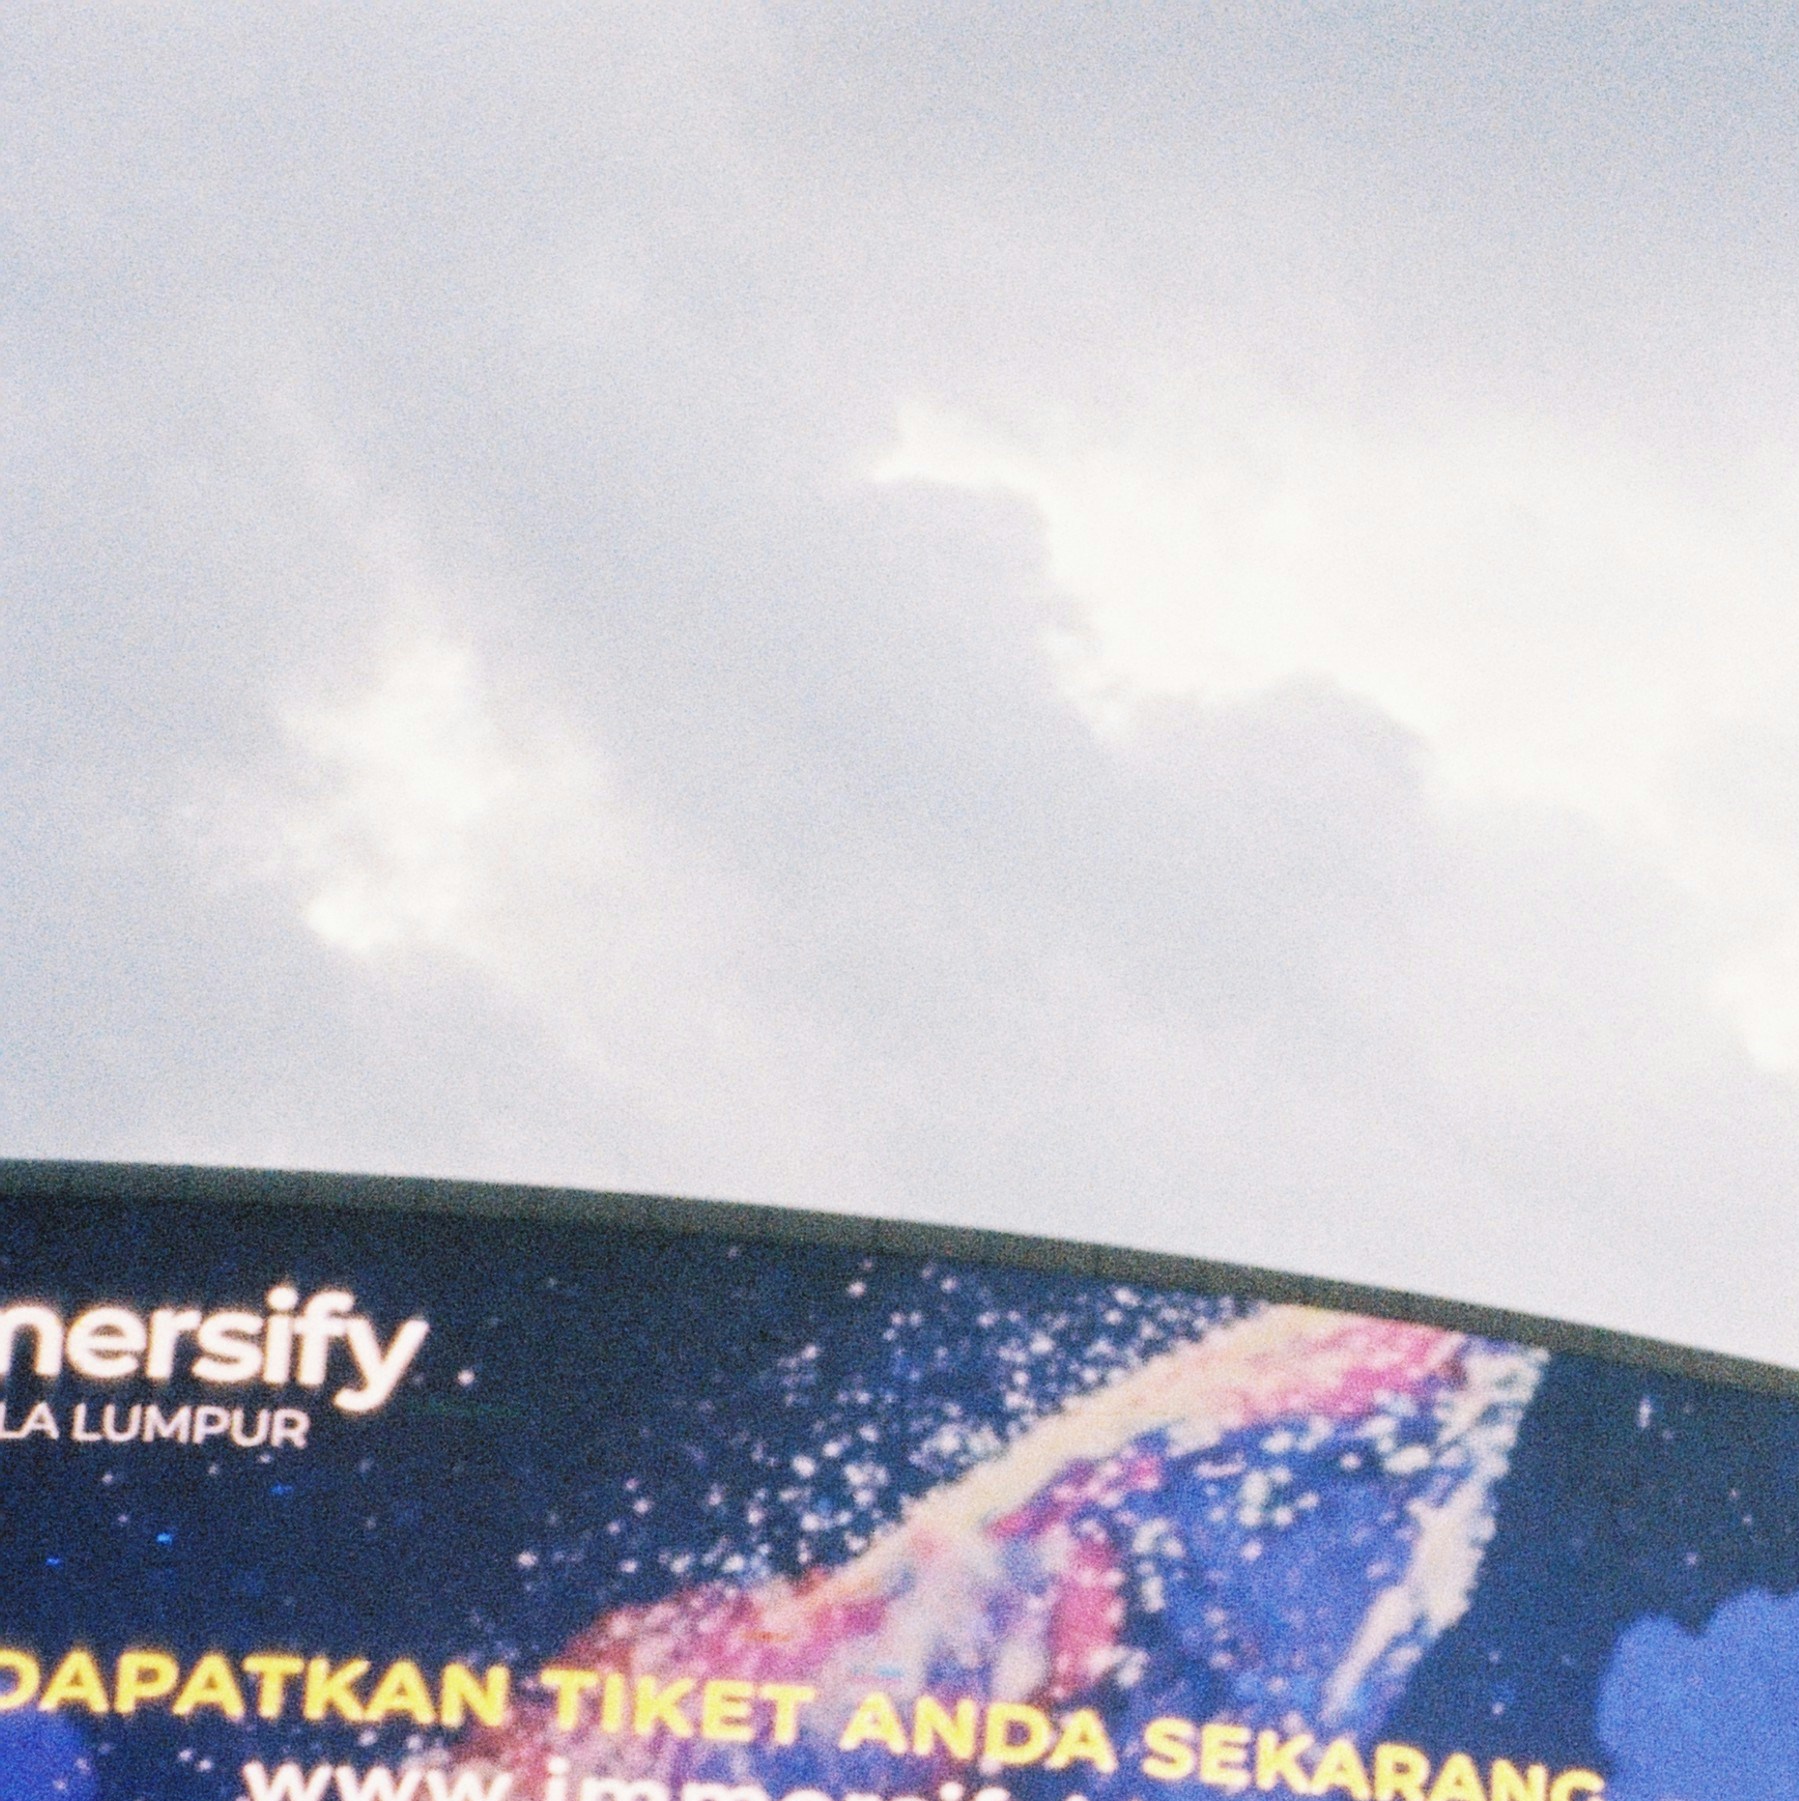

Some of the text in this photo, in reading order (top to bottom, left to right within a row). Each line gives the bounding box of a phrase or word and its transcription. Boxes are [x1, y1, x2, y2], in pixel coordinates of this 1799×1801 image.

[71, 1403, 311, 1450] LUMPUR
[0, 1648, 508, 1727] DAPATKAN
[544, 1667, 817, 1746] TIKET
[840, 1692, 1114, 1774] ANDA
